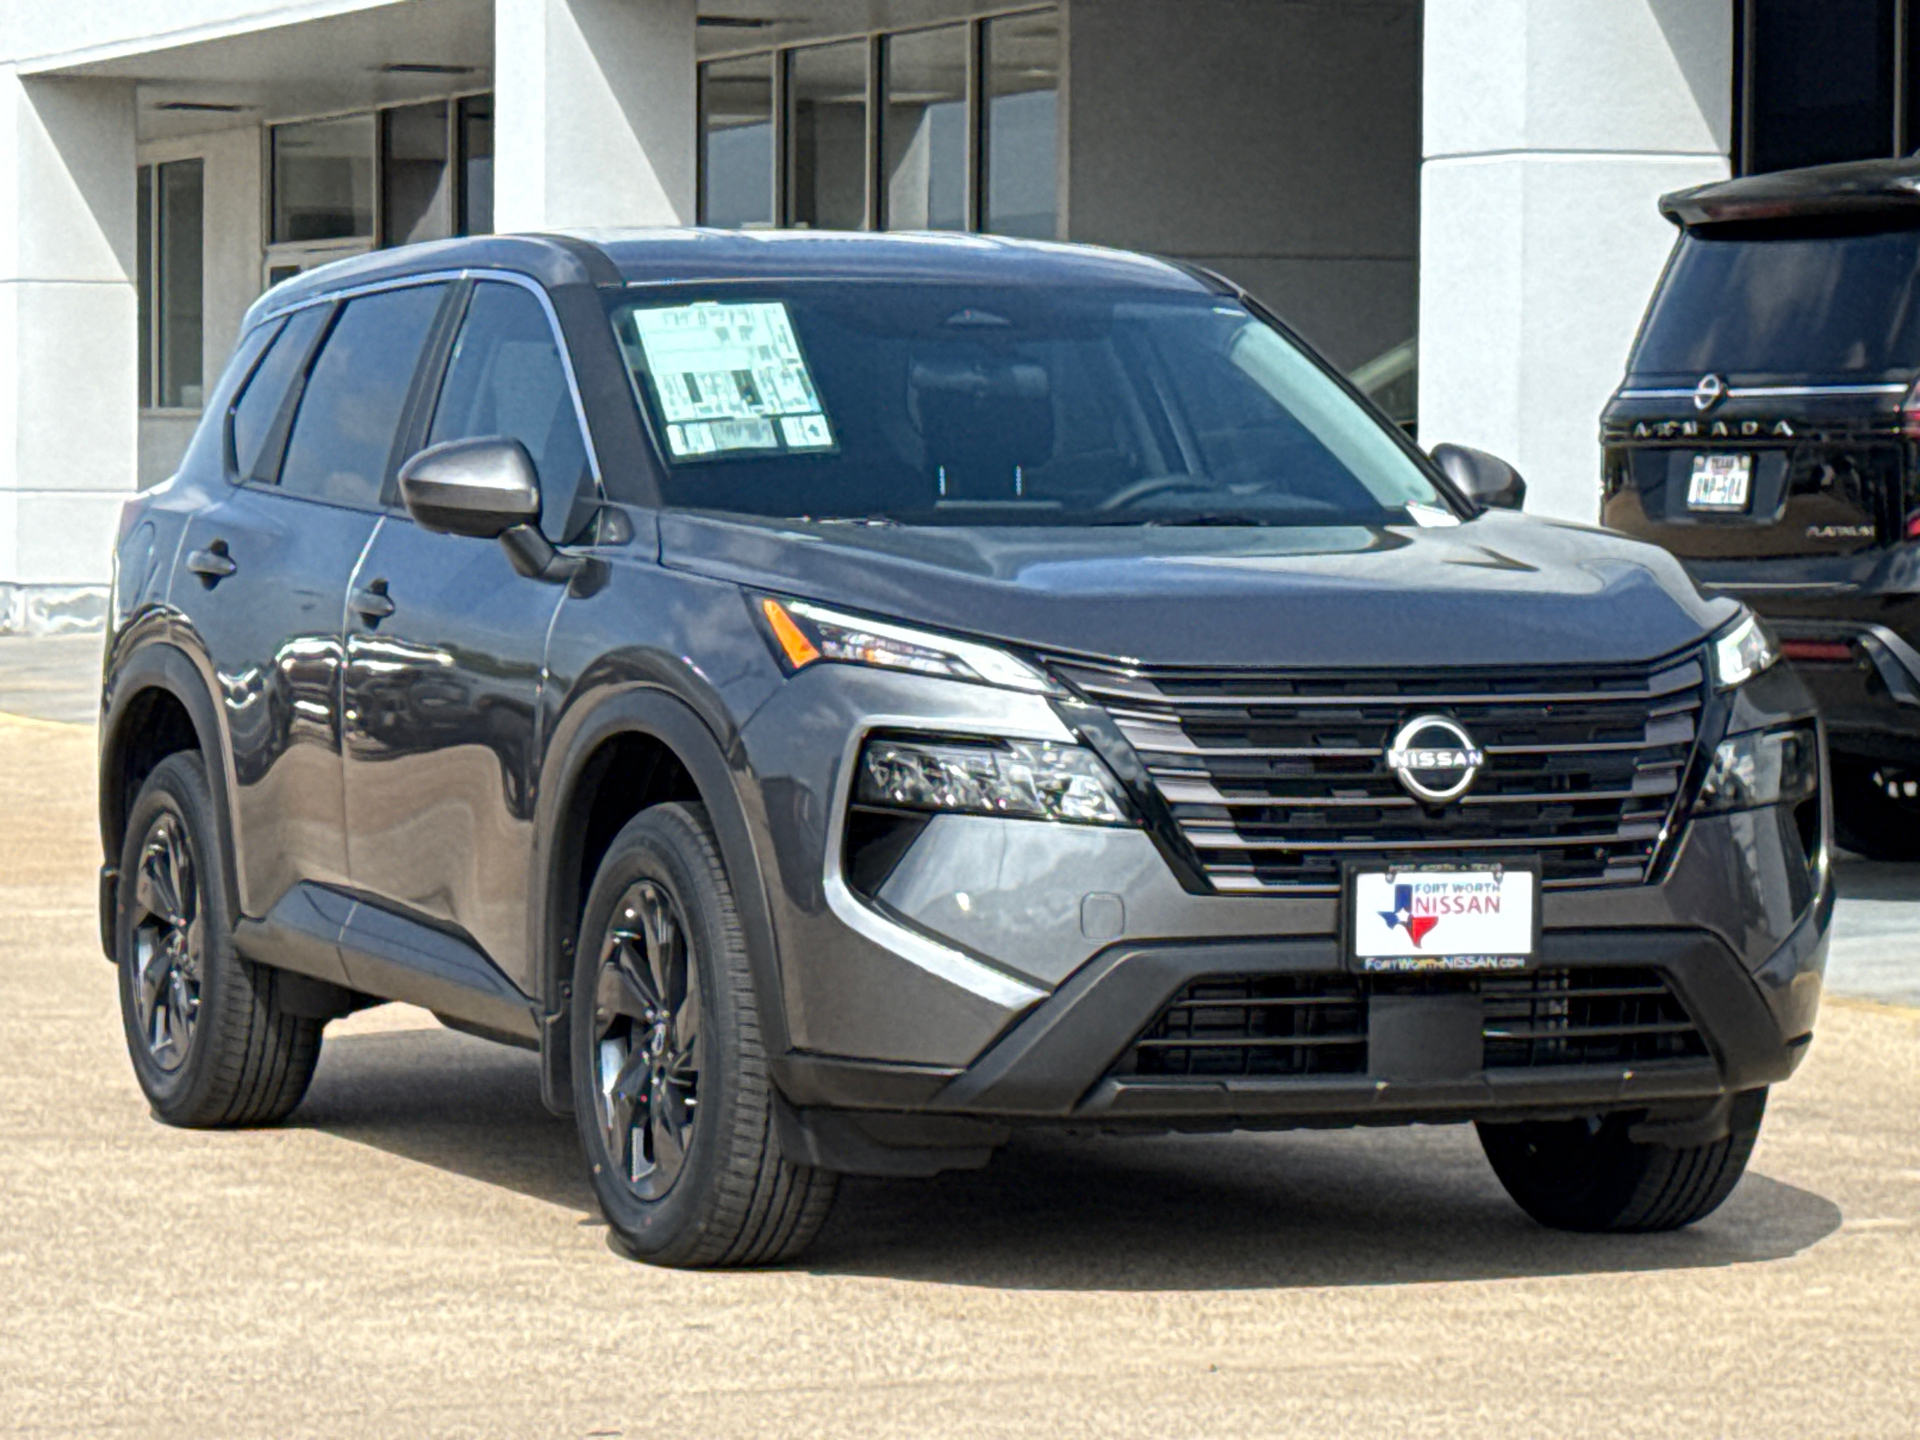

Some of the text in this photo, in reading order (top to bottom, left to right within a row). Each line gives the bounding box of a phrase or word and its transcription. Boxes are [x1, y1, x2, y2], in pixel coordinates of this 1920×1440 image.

[1388, 749, 1483, 768] NISSAN
[1414, 883, 1448, 894] FORT
[1415, 895, 1500, 914] NISSAN
